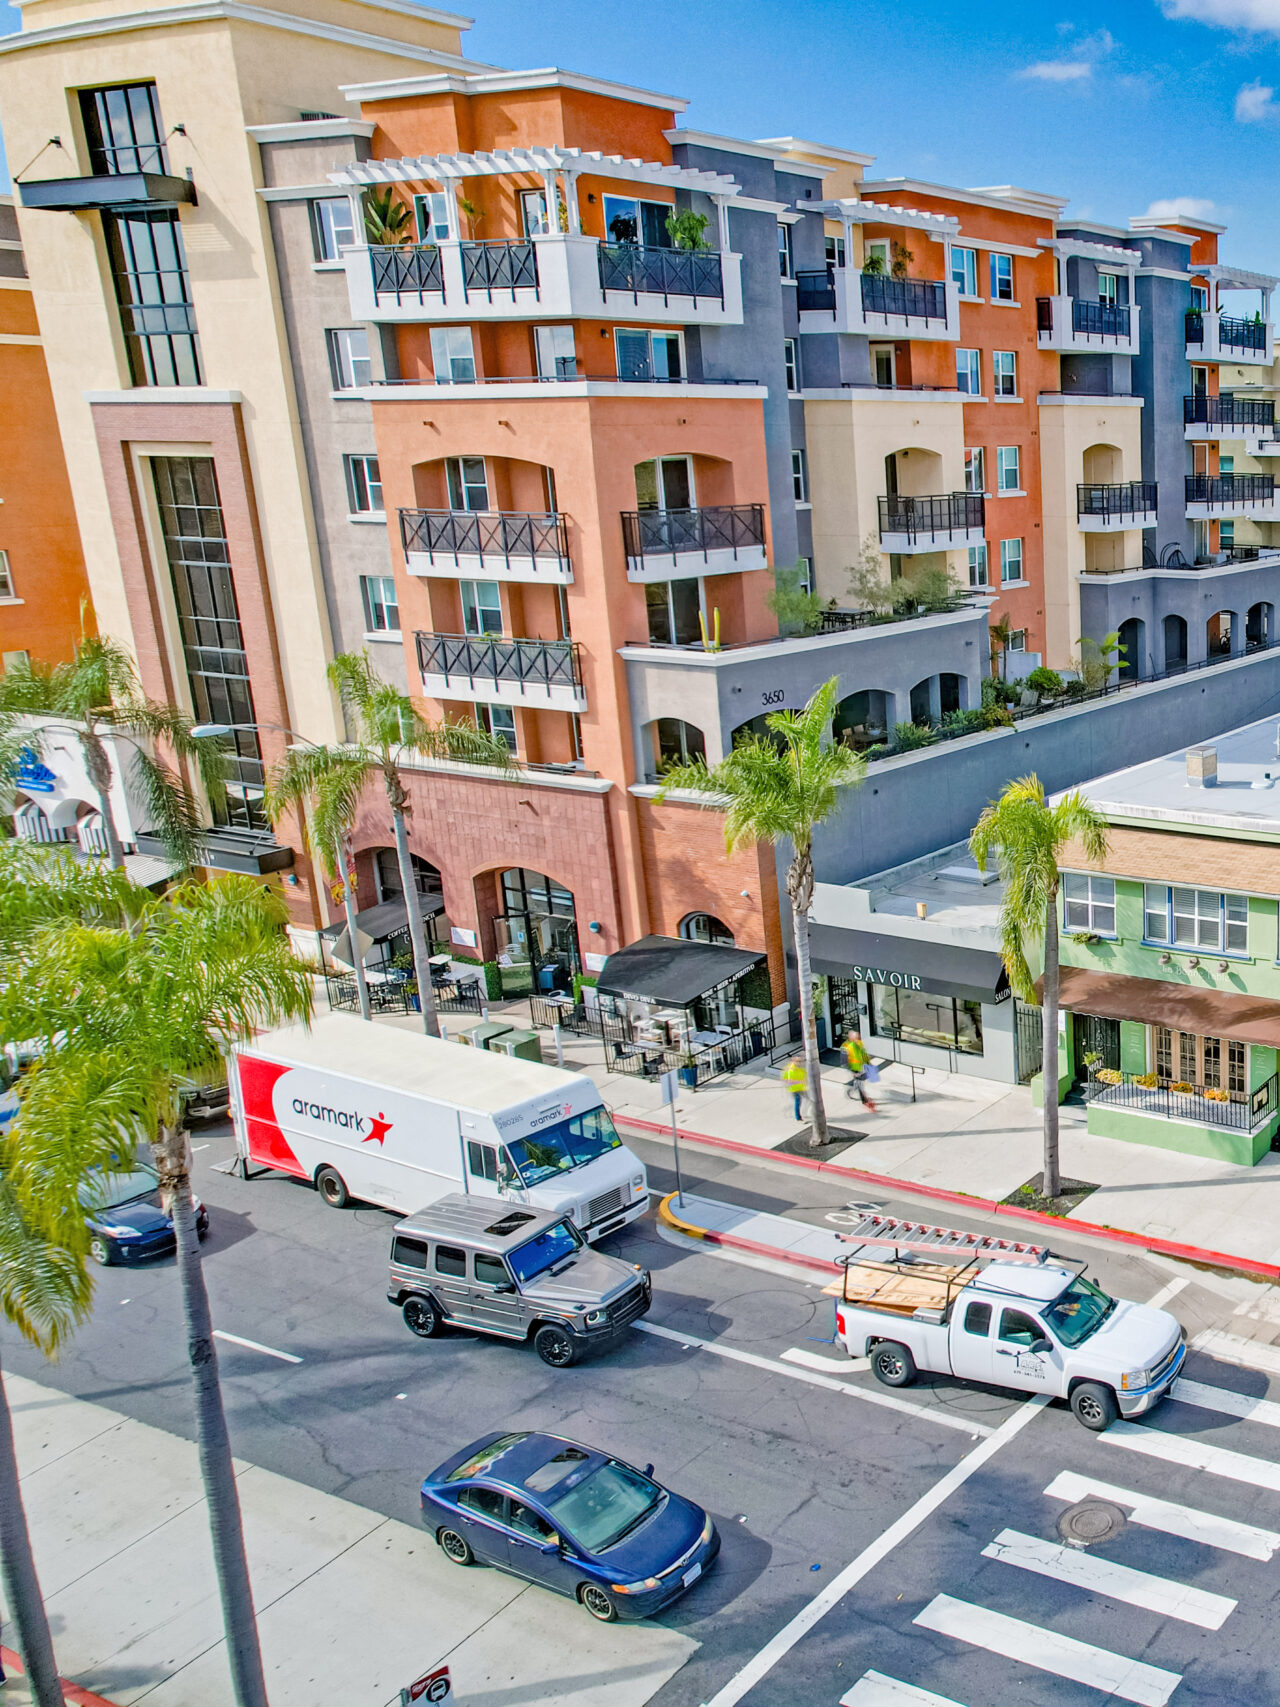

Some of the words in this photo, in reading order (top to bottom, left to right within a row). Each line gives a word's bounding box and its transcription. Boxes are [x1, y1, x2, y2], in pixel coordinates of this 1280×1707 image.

[762, 689, 785, 706] 3650
[388, 926, 408, 939] COFFEE
[853, 965, 921, 991] SAVOIR
[995, 988, 1011, 1003] SALON
[292, 1098, 365, 1133] aramark
[530, 1109, 563, 1128] aramark
